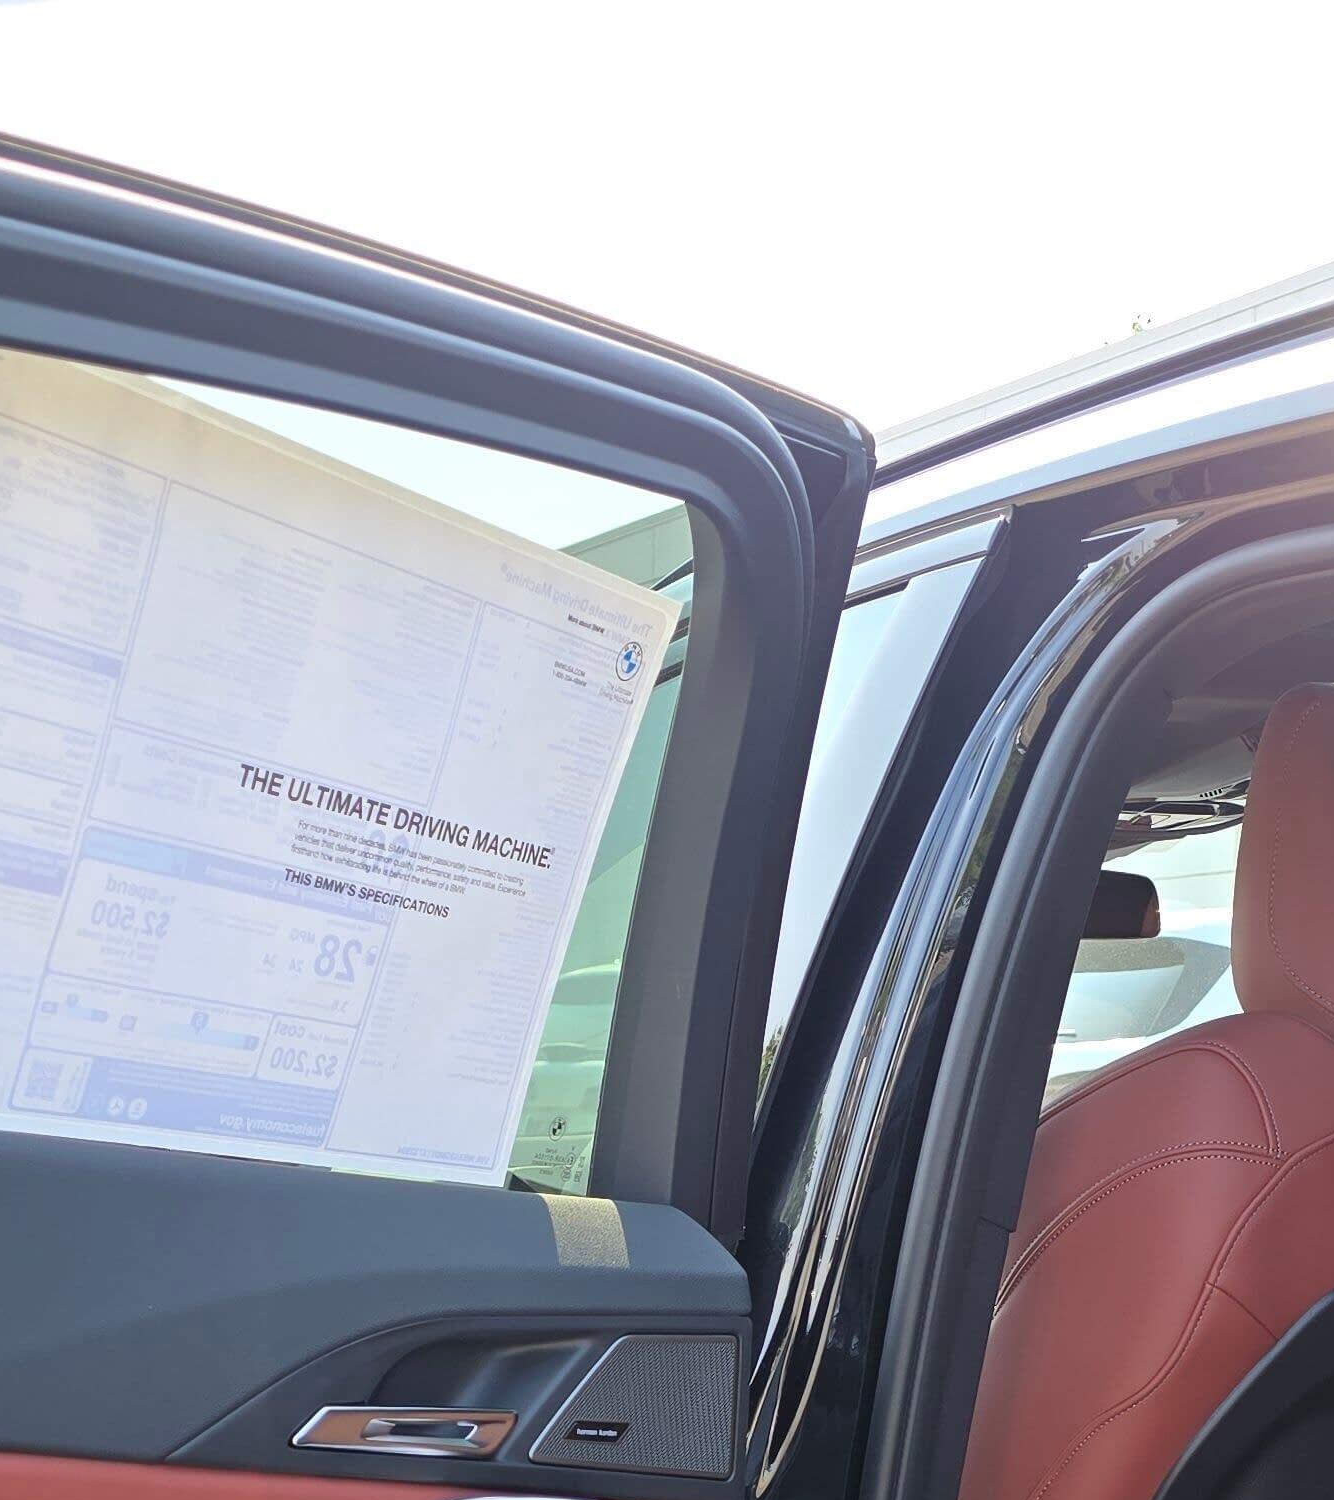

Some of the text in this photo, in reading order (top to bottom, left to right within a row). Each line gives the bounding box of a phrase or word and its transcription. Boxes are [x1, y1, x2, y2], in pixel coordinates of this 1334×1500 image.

[241, 763, 284, 797] THE
[288, 778, 391, 826] ULTIMATE
[393, 808, 470, 847] DRIVING
[310, 825, 327, 835] more
[328, 828, 343, 839] than
[388, 843, 406, 855] BMW
[406, 848, 418, 859] has
[418, 852, 432, 862] been
[335, 843, 357, 855] deliver
[357, 850, 393, 864] uncommon
[470, 878, 481, 886] and
[285, 868, 312, 886] THIS
[314, 876, 356, 896] BMW'S
[358, 887, 450, 918] SPECIFICATIONS
[389, 869, 411, 881] behind
